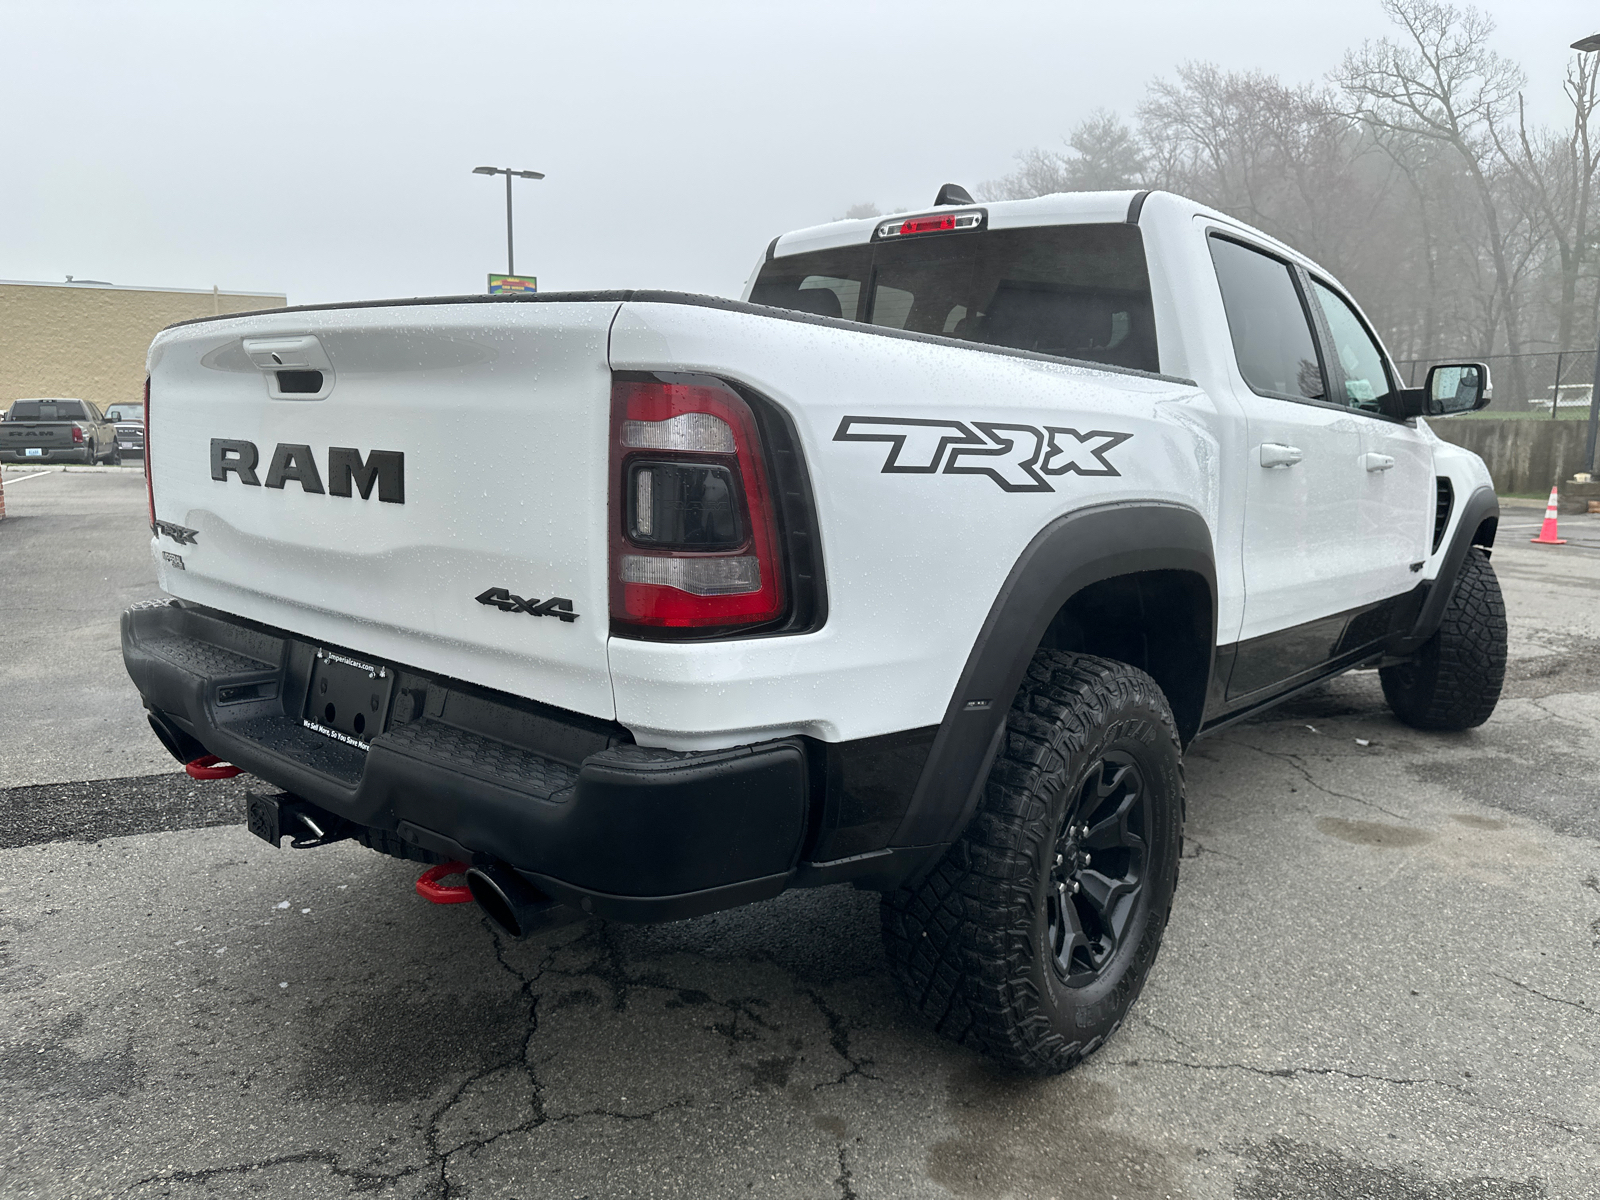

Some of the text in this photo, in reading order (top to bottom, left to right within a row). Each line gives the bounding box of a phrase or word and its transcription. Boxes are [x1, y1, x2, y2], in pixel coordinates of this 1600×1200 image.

[832, 415, 1134, 492] TRX
[210, 437, 405, 505] RAM
[664, 500, 728, 512] RAM
[328, 652, 374, 672] Imperialcars.com
[303, 719, 311, 728] We
[310, 722, 319, 731] Sell
[319, 725, 330, 737] More,
[330, 730, 338, 738] So
[337, 733, 347, 742] You
[346, 737, 358, 747] Save
